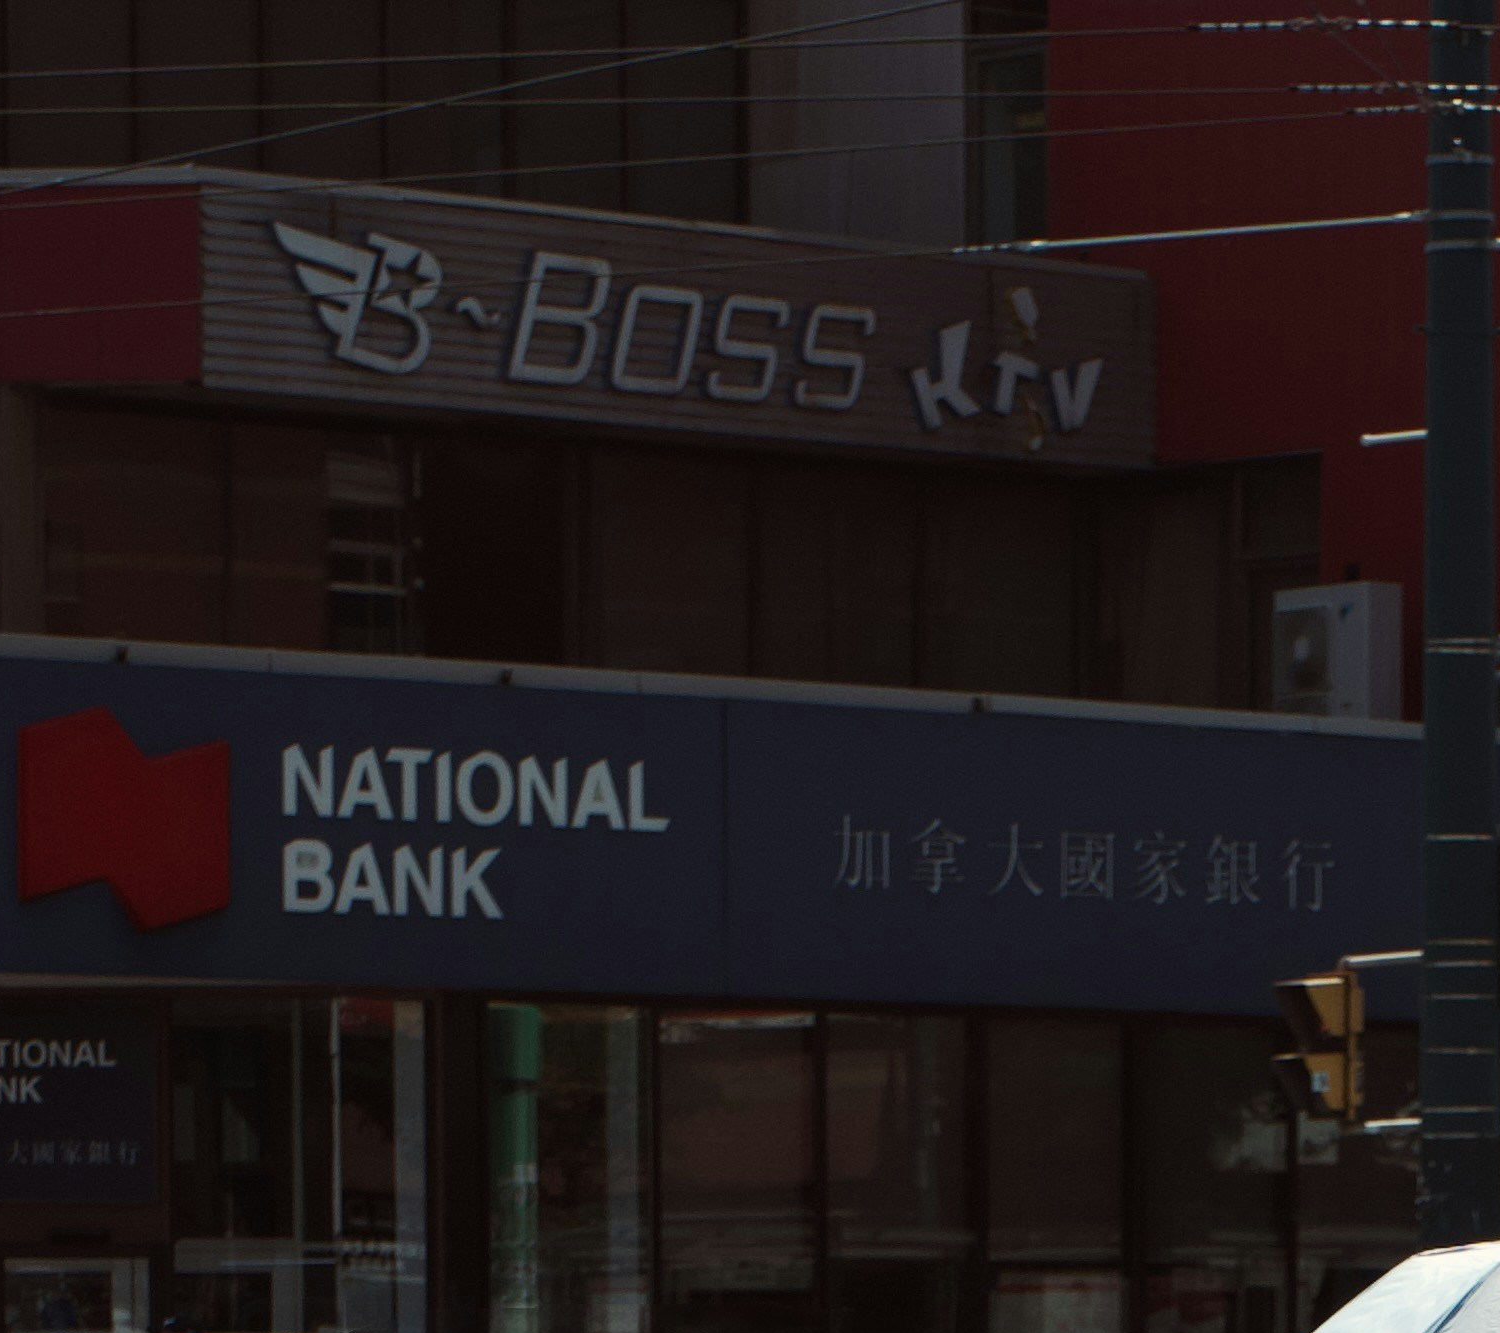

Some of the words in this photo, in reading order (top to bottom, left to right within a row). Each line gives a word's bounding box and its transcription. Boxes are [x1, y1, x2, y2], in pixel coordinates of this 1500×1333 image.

[281, 742, 672, 833] NATIONAL
[282, 837, 505, 920] BANK
[832, 814, 1336, 912] 加拿大國家銀行
